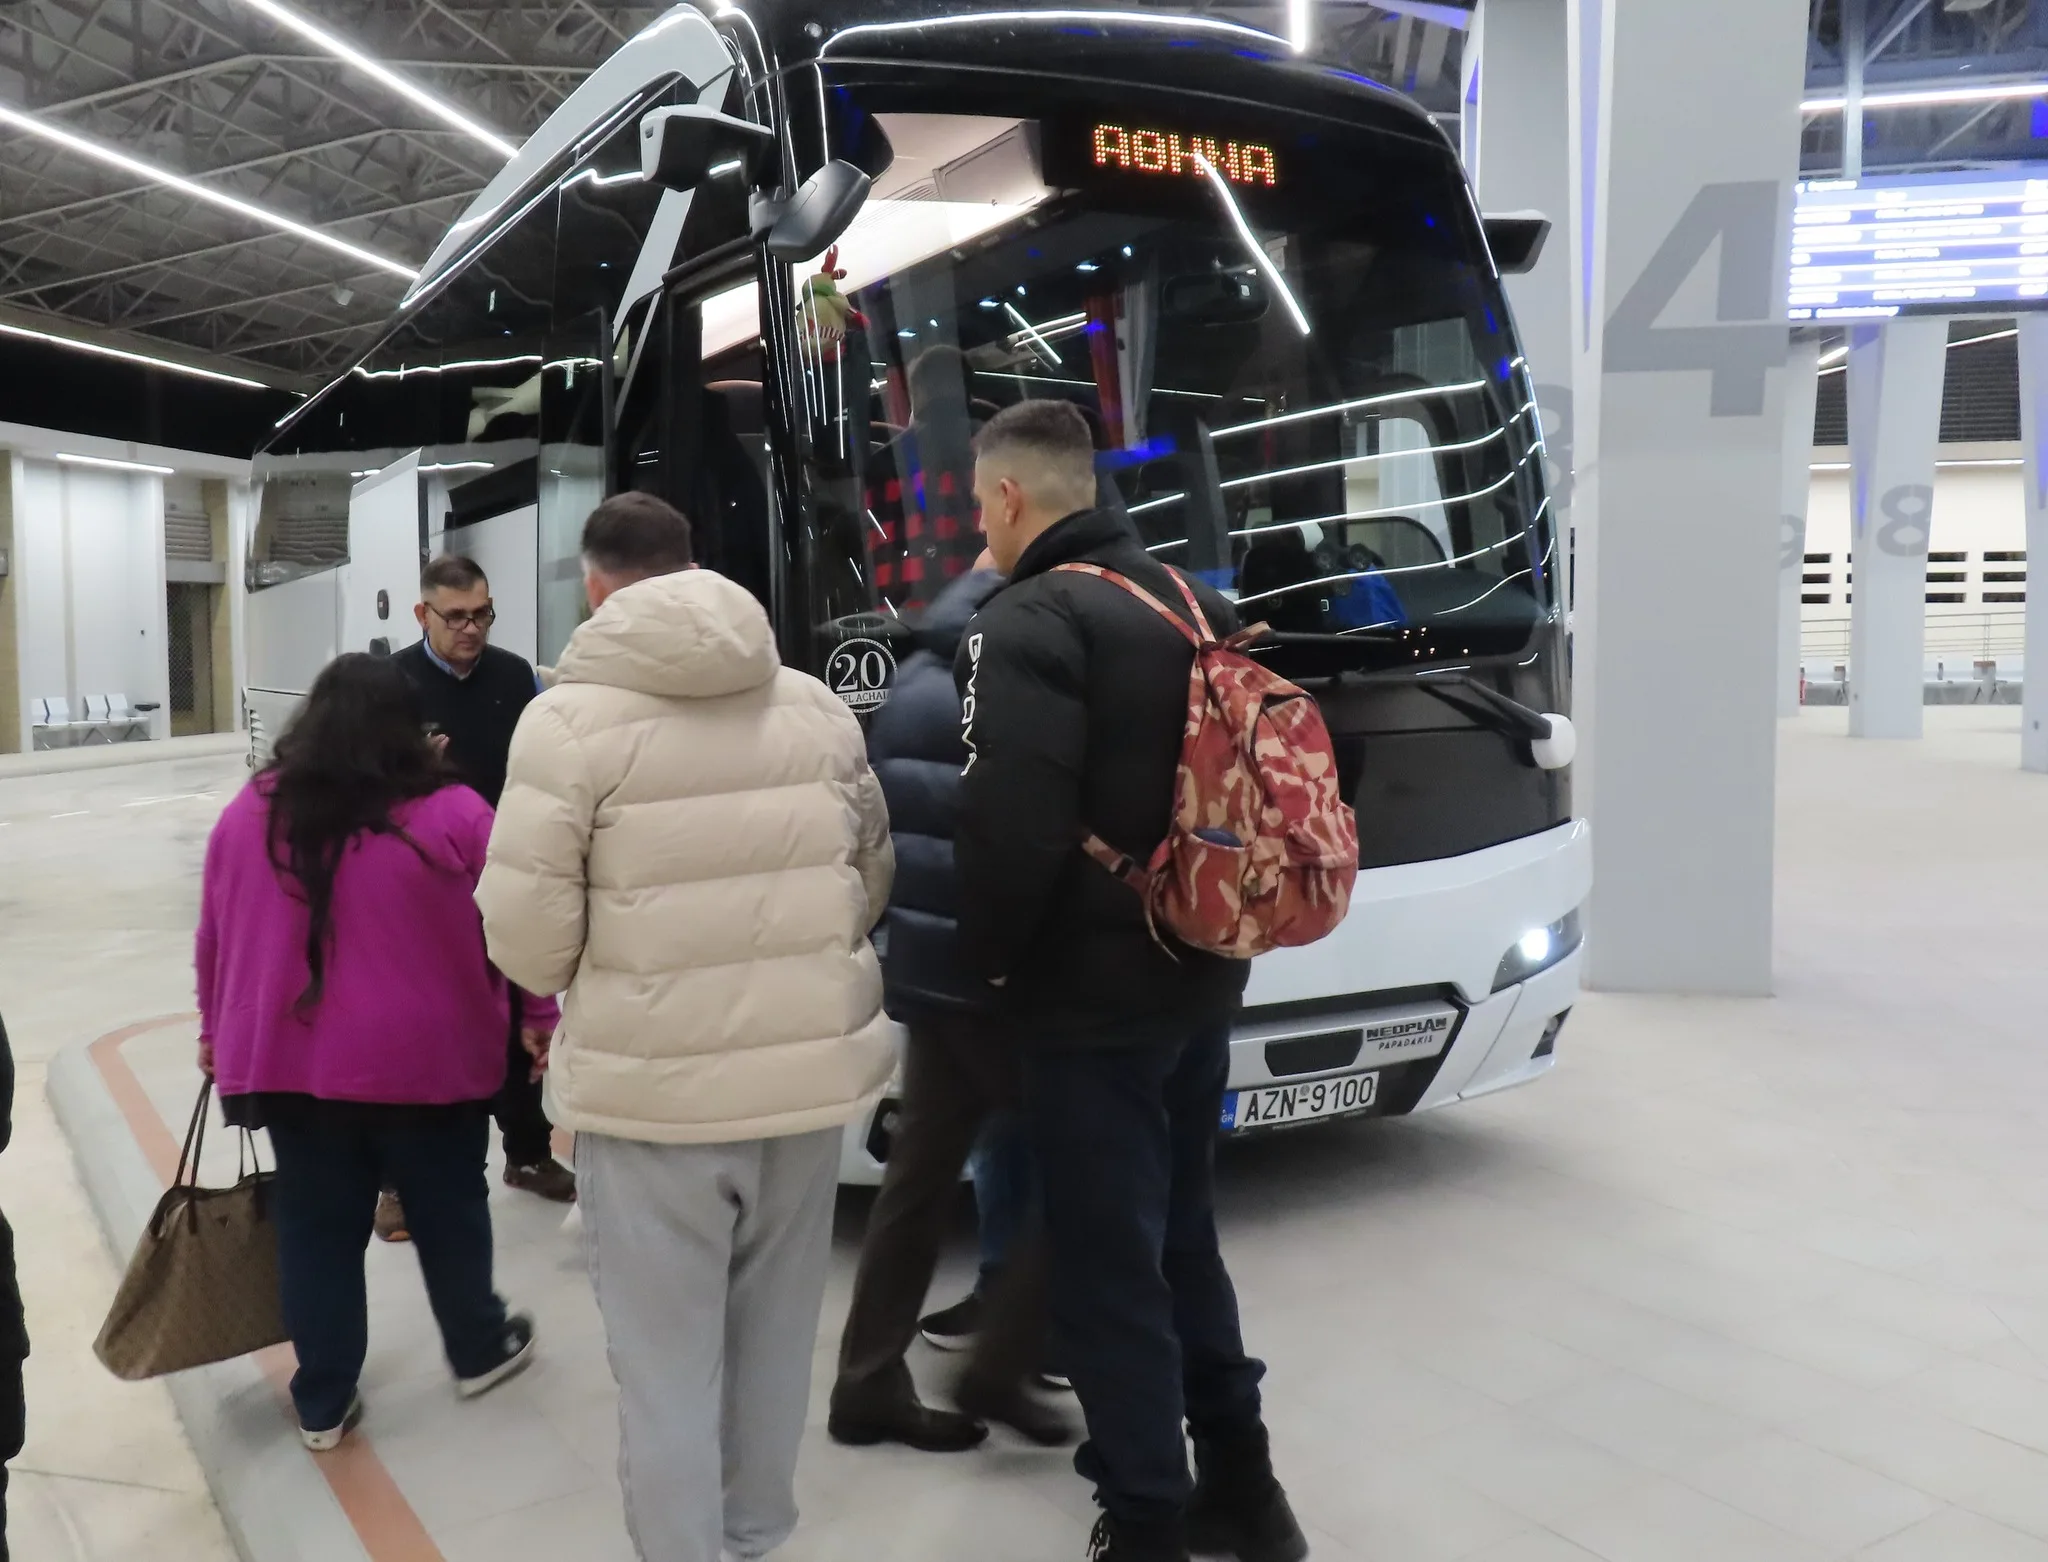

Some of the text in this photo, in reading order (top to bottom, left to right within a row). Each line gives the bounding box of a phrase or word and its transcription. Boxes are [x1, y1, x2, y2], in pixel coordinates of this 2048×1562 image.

[1093, 123, 1277, 186] ΑΘΗΝΑ
[1603, 180, 1790, 417] 4
[1876, 484, 1934, 557] 8
[835, 650, 887, 692] 20
[1366, 1018, 1447, 1040] NEOPLAN
[1378, 1035, 1433, 1051] PAPADAKIS
[1220, 1113, 1234, 1124] GR
